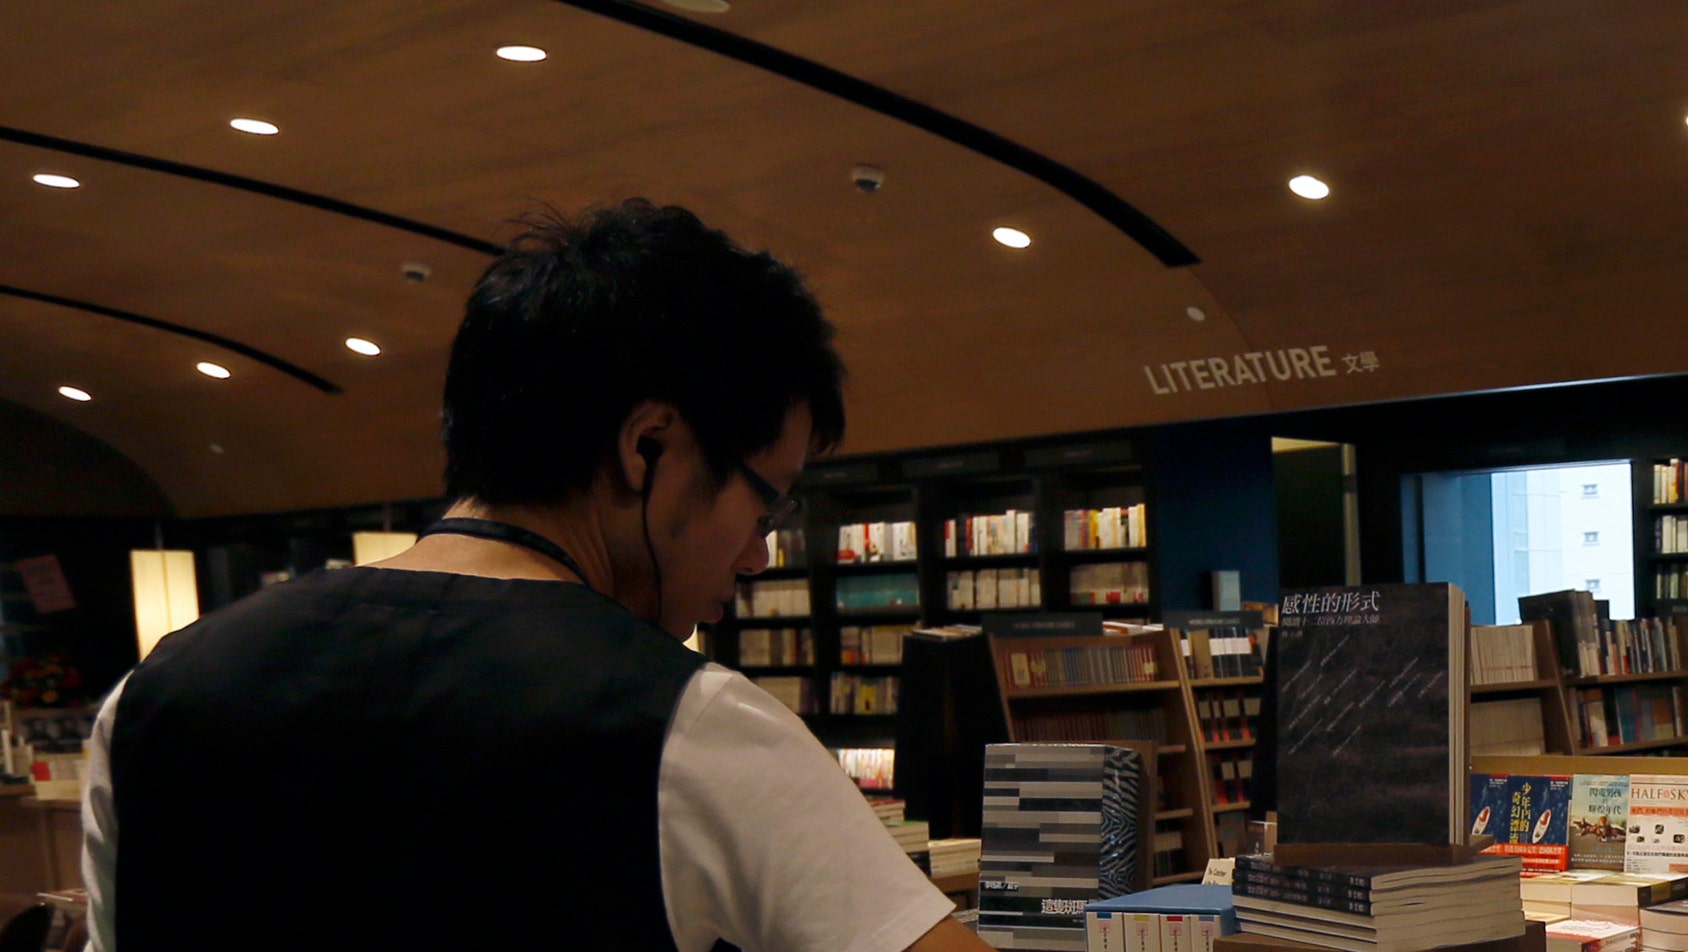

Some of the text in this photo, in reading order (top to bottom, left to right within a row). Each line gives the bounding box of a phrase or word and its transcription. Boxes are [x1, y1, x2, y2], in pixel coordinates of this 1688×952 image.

[1144, 346, 1336, 394] LITERATURE
[1342, 351, 1380, 374] 文學
[1281, 590, 1381, 615] 感性的形式
[1631, 787, 1664, 799] HALF
